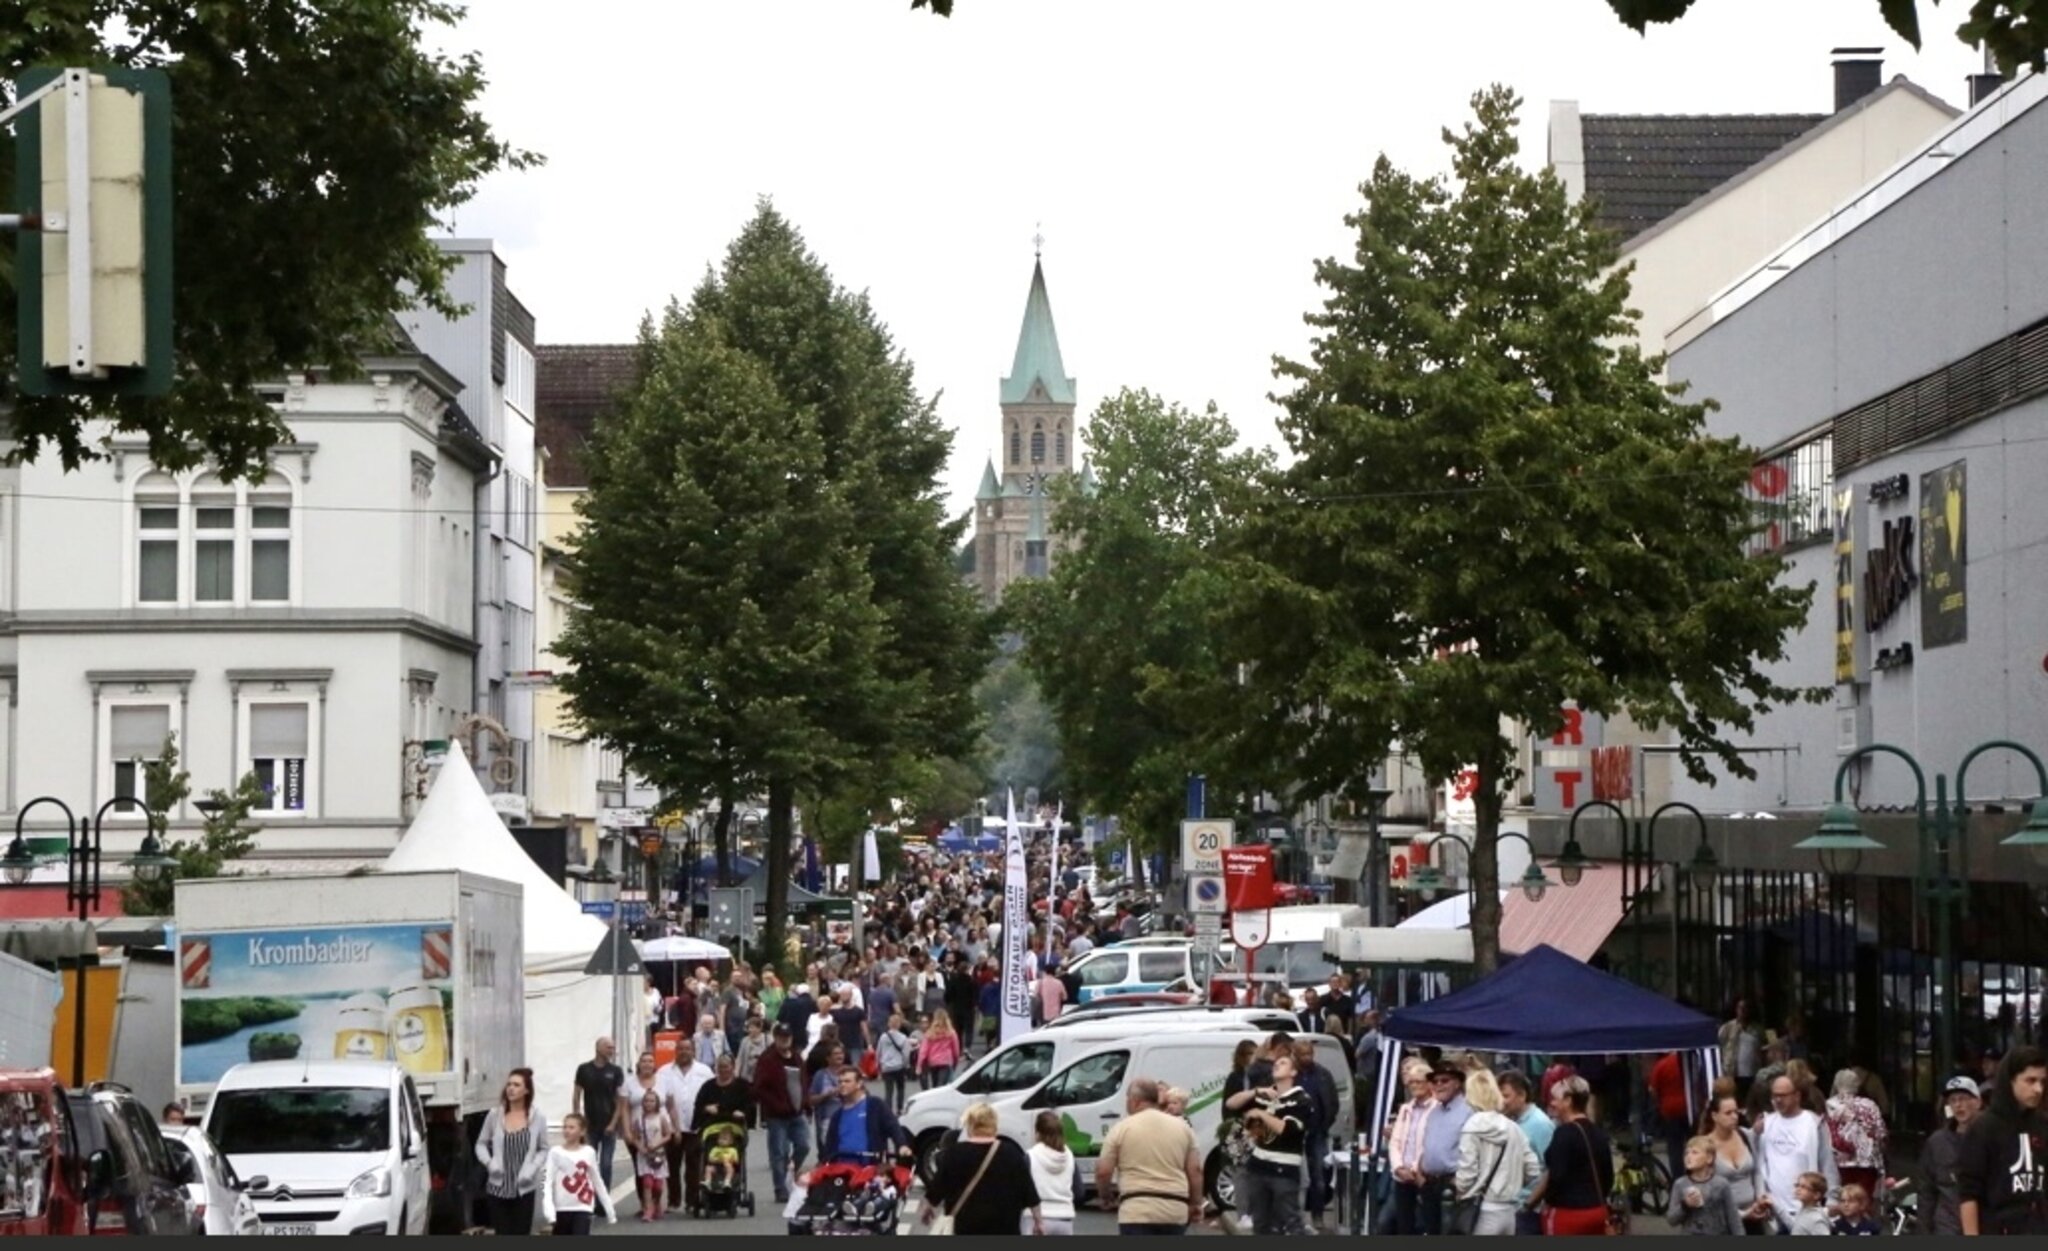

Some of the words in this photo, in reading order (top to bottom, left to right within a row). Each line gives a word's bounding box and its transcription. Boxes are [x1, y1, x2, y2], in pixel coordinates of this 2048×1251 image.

[1199, 833, 1219, 850] 20
[1195, 860, 1219, 869] ZONE
[250, 935, 373, 967] Krombacher
[1009, 935, 1020, 1012] AUTOHAUS
